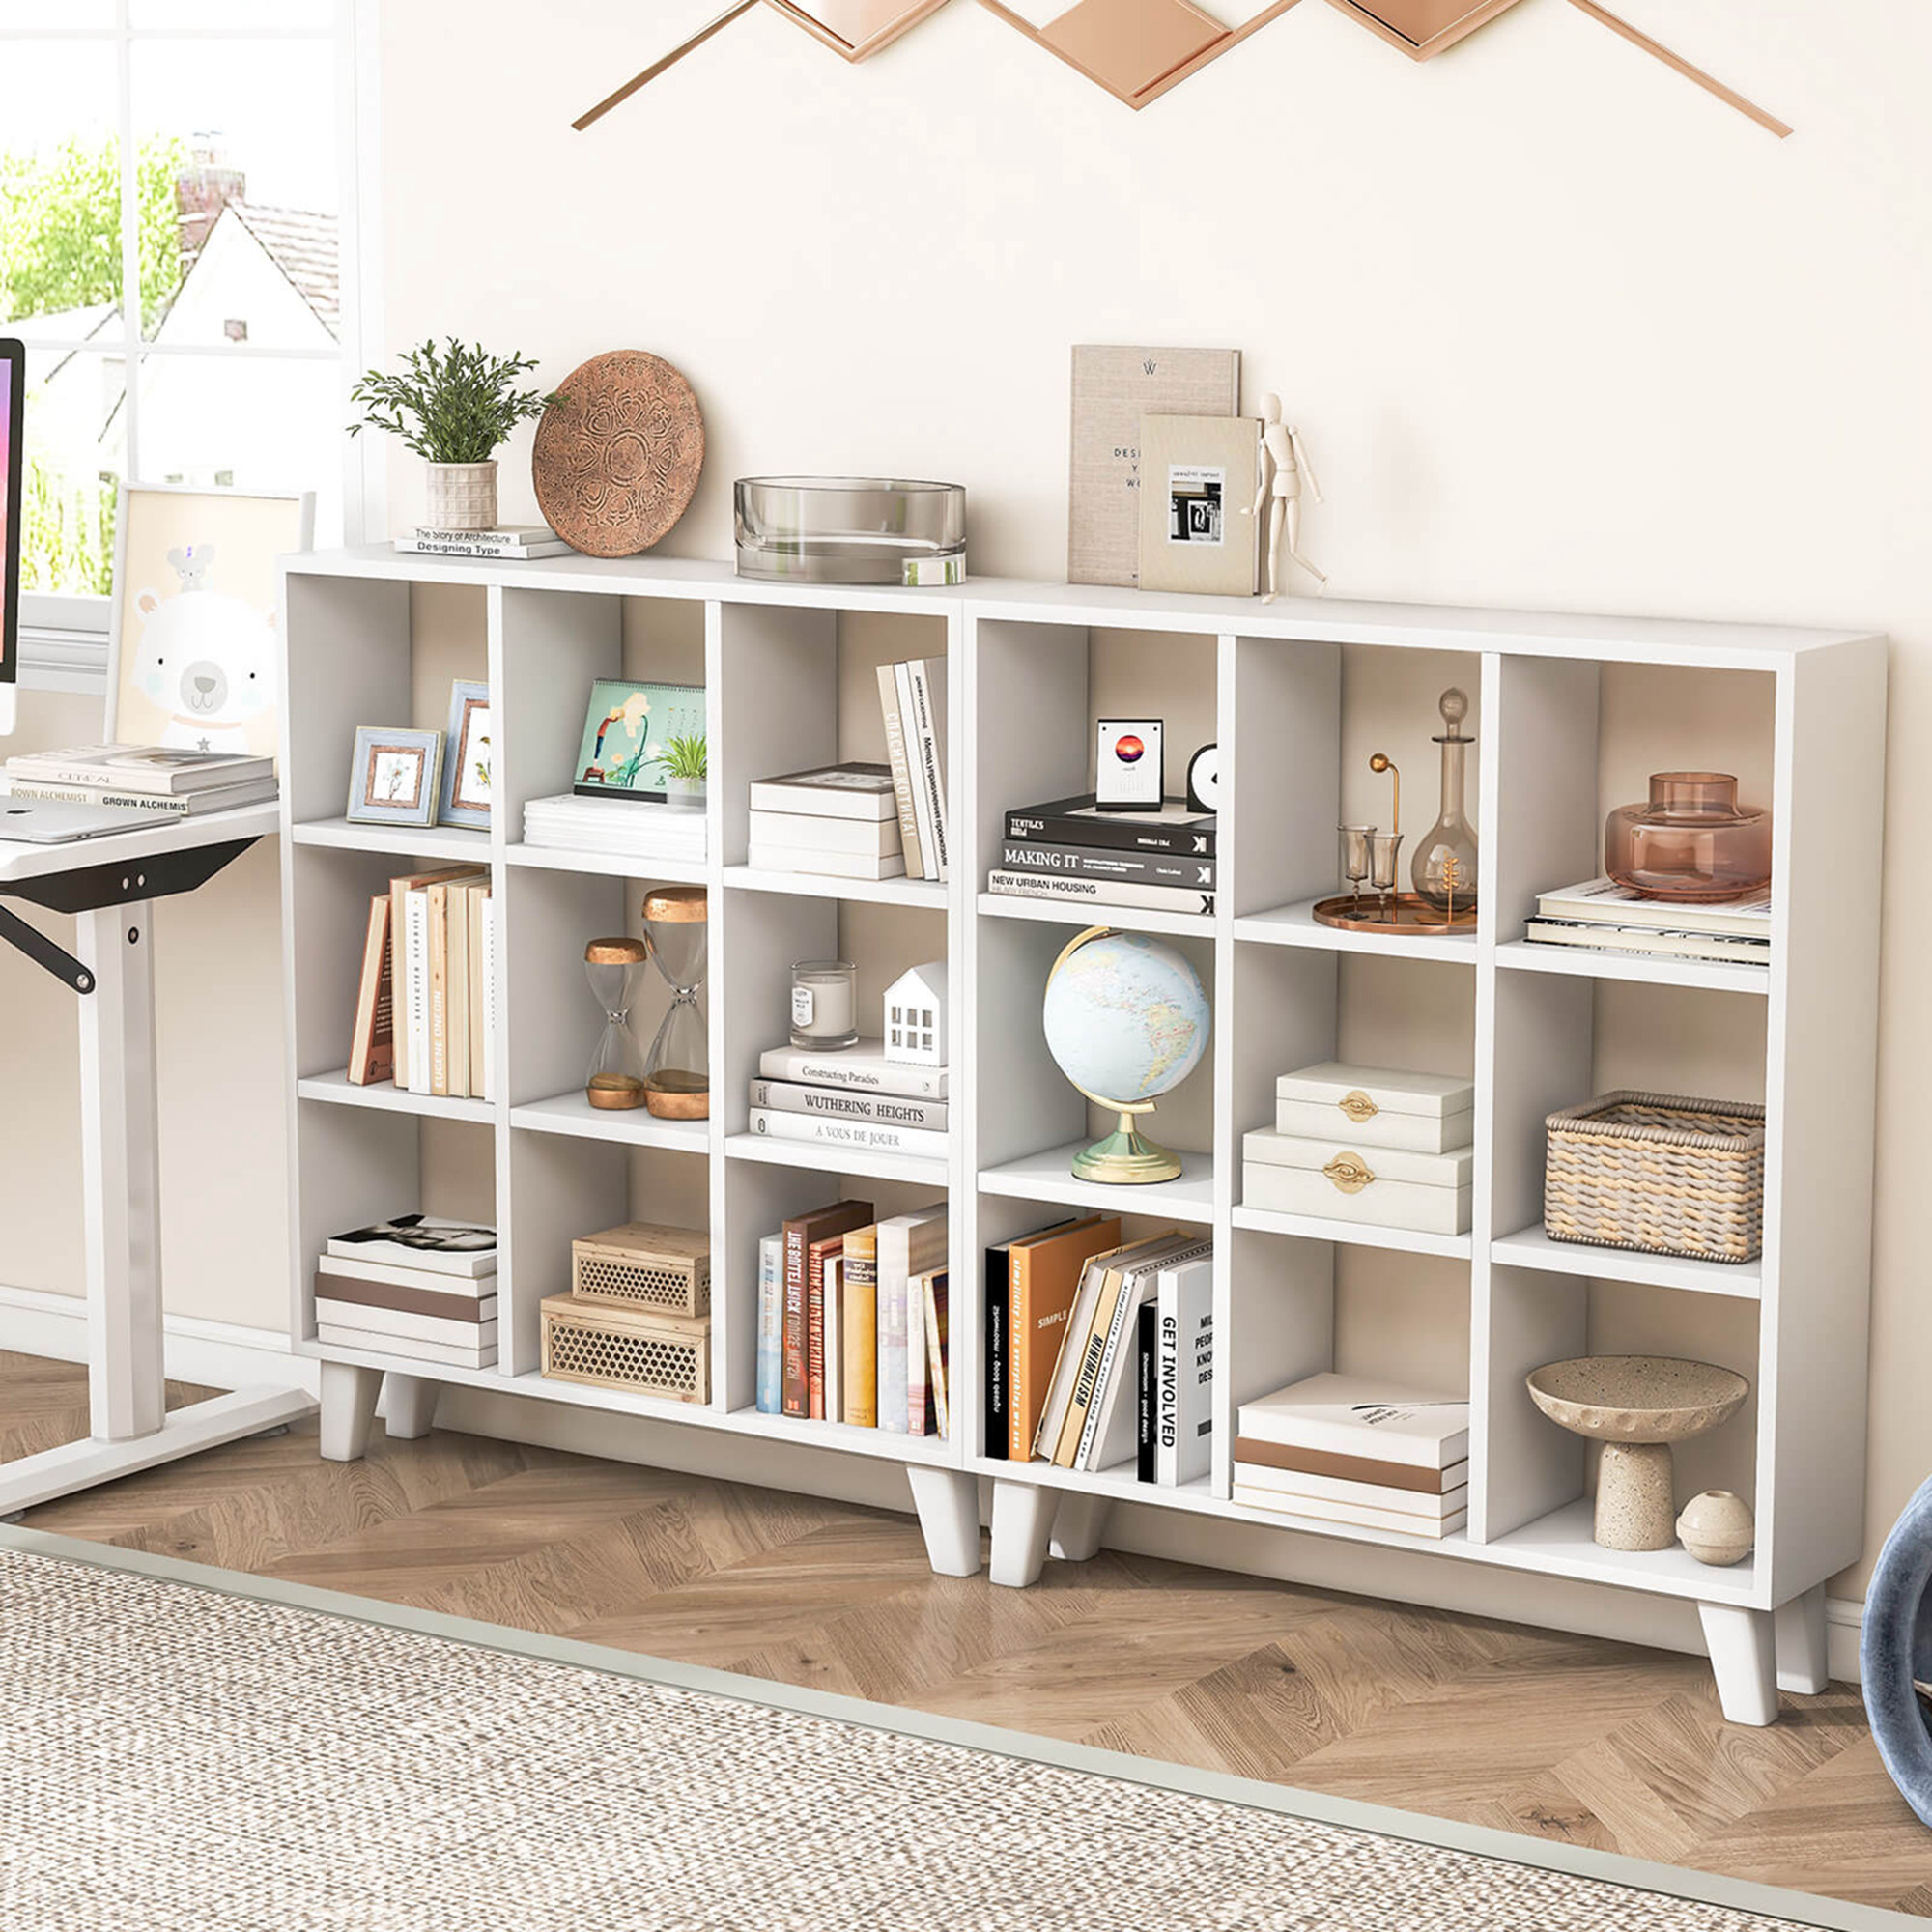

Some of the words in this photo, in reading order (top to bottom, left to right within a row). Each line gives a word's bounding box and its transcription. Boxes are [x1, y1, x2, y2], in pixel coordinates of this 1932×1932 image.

[415, 528, 431, 539] The
[432, 531, 454, 541] Story
[464, 532, 511, 544] Architecture
[417, 541, 472, 554] Designing
[475, 545, 500, 555] Type
[102, 797, 137, 808] GROWN
[140, 800, 188, 811] ALCHEMIS
[1005, 849, 1061, 867] MAKING
[1064, 855, 1079, 868] IT
[992, 875, 1014, 886] NEW
[1016, 878, 1050, 890] URBAN
[1052, 881, 1096, 895] HOUSING
[433, 1041, 444, 1088] EUGENE
[802, 1066, 848, 1083] Constructing
[805, 1094, 871, 1116] WUTHERING
[877, 1103, 924, 1122] HEIGHTS
[826, 1126, 850, 1141] VOUS
[854, 1130, 867, 1142] DE
[869, 1132, 899, 1147] JOUER
[1011, 1259, 1022, 1315] simplicity
[1013, 1320, 1021, 1329] is
[1161, 1317, 1177, 1350] GET
[1012, 1333, 1021, 1345] in
[1011, 1349, 1022, 1408] everything
[1074, 1333, 1103, 1407] MINIMALISM
[1141, 1352, 1150, 1392] Showroom
[1140, 1399, 1149, 1418] good
[1161, 1355, 1177, 1447] INVOLVED
[1012, 1411, 1020, 1427] we
[1012, 1430, 1021, 1450] see
[1140, 1420, 1149, 1443] design
